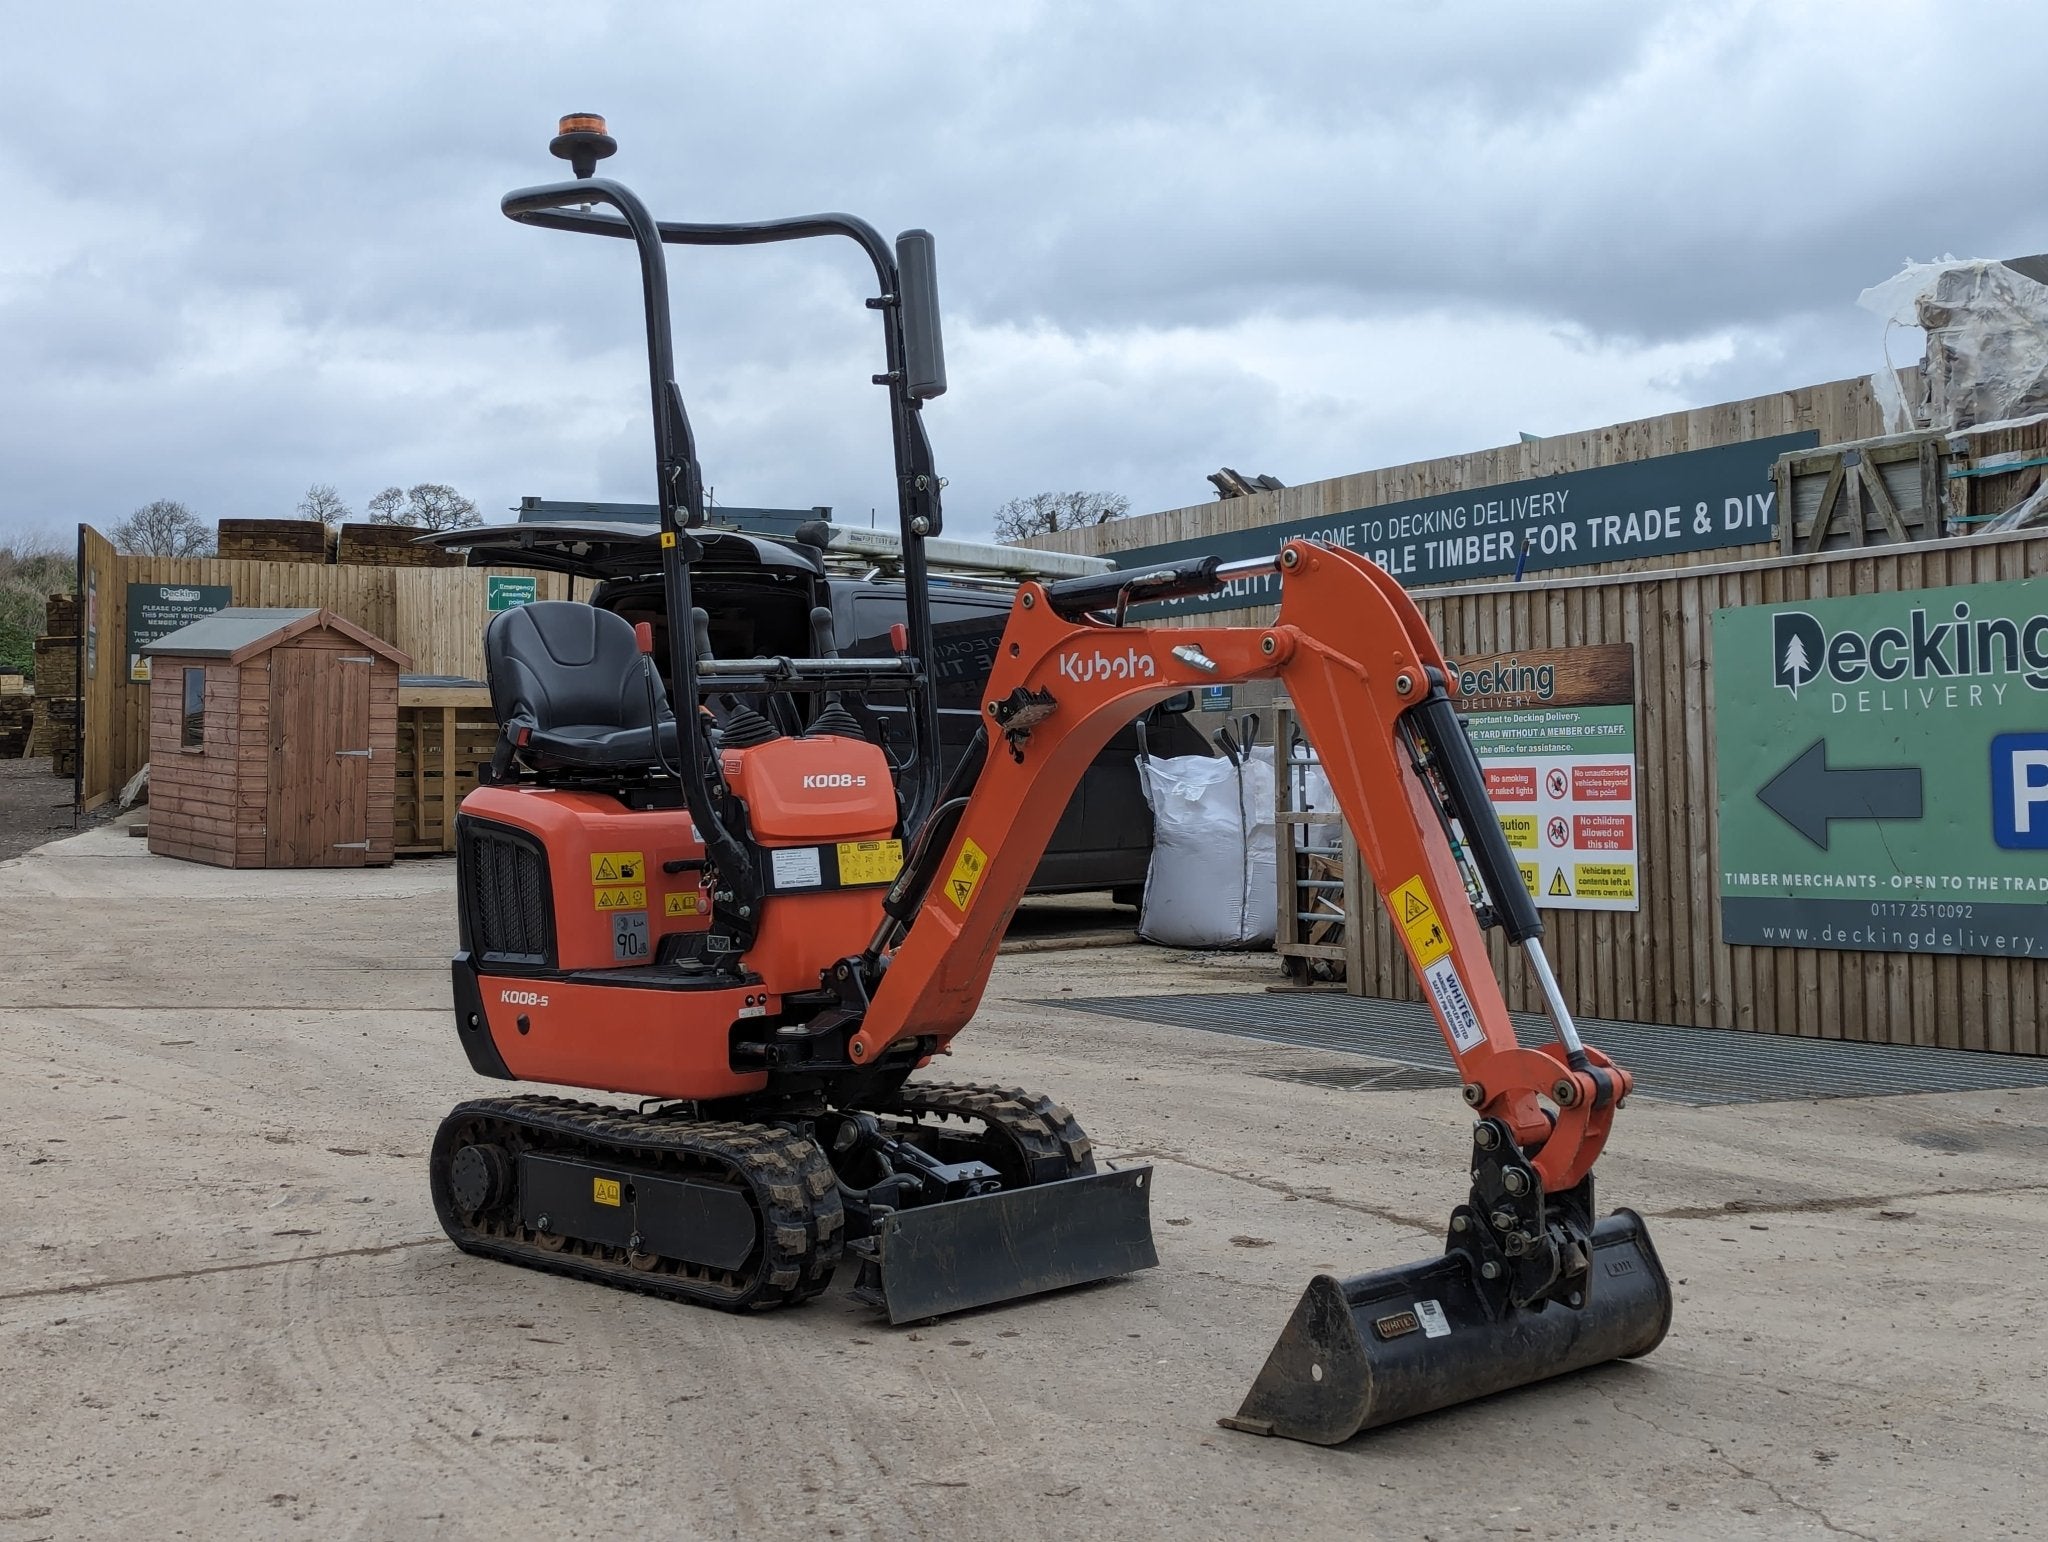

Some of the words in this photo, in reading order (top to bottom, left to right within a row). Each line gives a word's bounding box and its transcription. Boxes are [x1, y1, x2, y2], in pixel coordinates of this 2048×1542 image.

[1361, 521, 1383, 543] TO
[1389, 506, 1467, 539] DECKING
[1474, 490, 1570, 524] DELIVERY
[1425, 531, 1515, 571] TIMBER
[1525, 521, 1578, 557] FOR
[1586, 505, 1682, 549] TRADE
[1693, 501, 1712, 535] &
[1725, 491, 1776, 531] DIY
[160, 587, 201, 601] Decking
[142, 604, 169, 612] PLEASE
[1772, 601, 2048, 701] Decking
[1059, 647, 1155, 683] Kubota
[1462, 695, 1533, 710] DELIVERY
[1832, 683, 2008, 714] DELIVERY
[1468, 714, 1503, 726] mportant
[1504, 714, 1512, 723] to
[1513, 712, 1544, 725] Decking
[1546, 711, 1581, 724] Delivery.
[1479, 729, 1501, 739] YARD
[1501, 727, 1538, 738] WITHOUT
[1540, 728, 1547, 737] A
[1547, 726, 1583, 737] MEMBER
[1584, 725, 1596, 735] OF
[1597, 724, 1626, 735] STAFF.
[1480, 744, 1492, 753] the
[1494, 743, 1515, 753] office
[1516, 743, 1527, 753] for
[1490, 774, 1500, 783] No
[1501, 774, 1529, 784] smoking
[1574, 769, 1583, 777] No
[803, 774, 866, 789] K008-5
[1575, 779, 1602, 787] vehicles
[1603, 778, 1628, 788] beyond
[1495, 787, 1515, 795] naked
[1516, 787, 1534, 796] lights
[1586, 788, 1598, 796] this
[1600, 788, 1617, 797] point
[2012, 750, 2048, 833] P
[1500, 819, 1530, 831] aution
[1580, 816, 1591, 825] No
[1592, 816, 1625, 825] children
[1582, 828, 1612, 837] allowed
[1613, 829, 1624, 837] on
[1587, 840, 1602, 849] this
[1604, 840, 1619, 849] site
[1581, 866, 1611, 875] Vehicles
[1612, 867, 1626, 875] and
[1579, 878, 1609, 886] contents
[1610, 877, 1622, 886] left
[1623, 878, 1630, 886] at
[1725, 872, 1779, 887] TIMBER
[1782, 874, 1877, 889] MERCHANTS
[1891, 875, 1937, 890] OPEN
[1942, 875, 1963, 890] TO
[1967, 876, 1999, 891] THE
[1576, 888, 1601, 896] owners
[1620, 887, 1633, 897] risk
[1871, 902, 1906, 918] 0117
[1911, 903, 1973, 920] 2510092
[617, 933, 638, 956] 90
[501, 989, 549, 1007] K008-5
[1446, 973, 1475, 1029] WHITES
